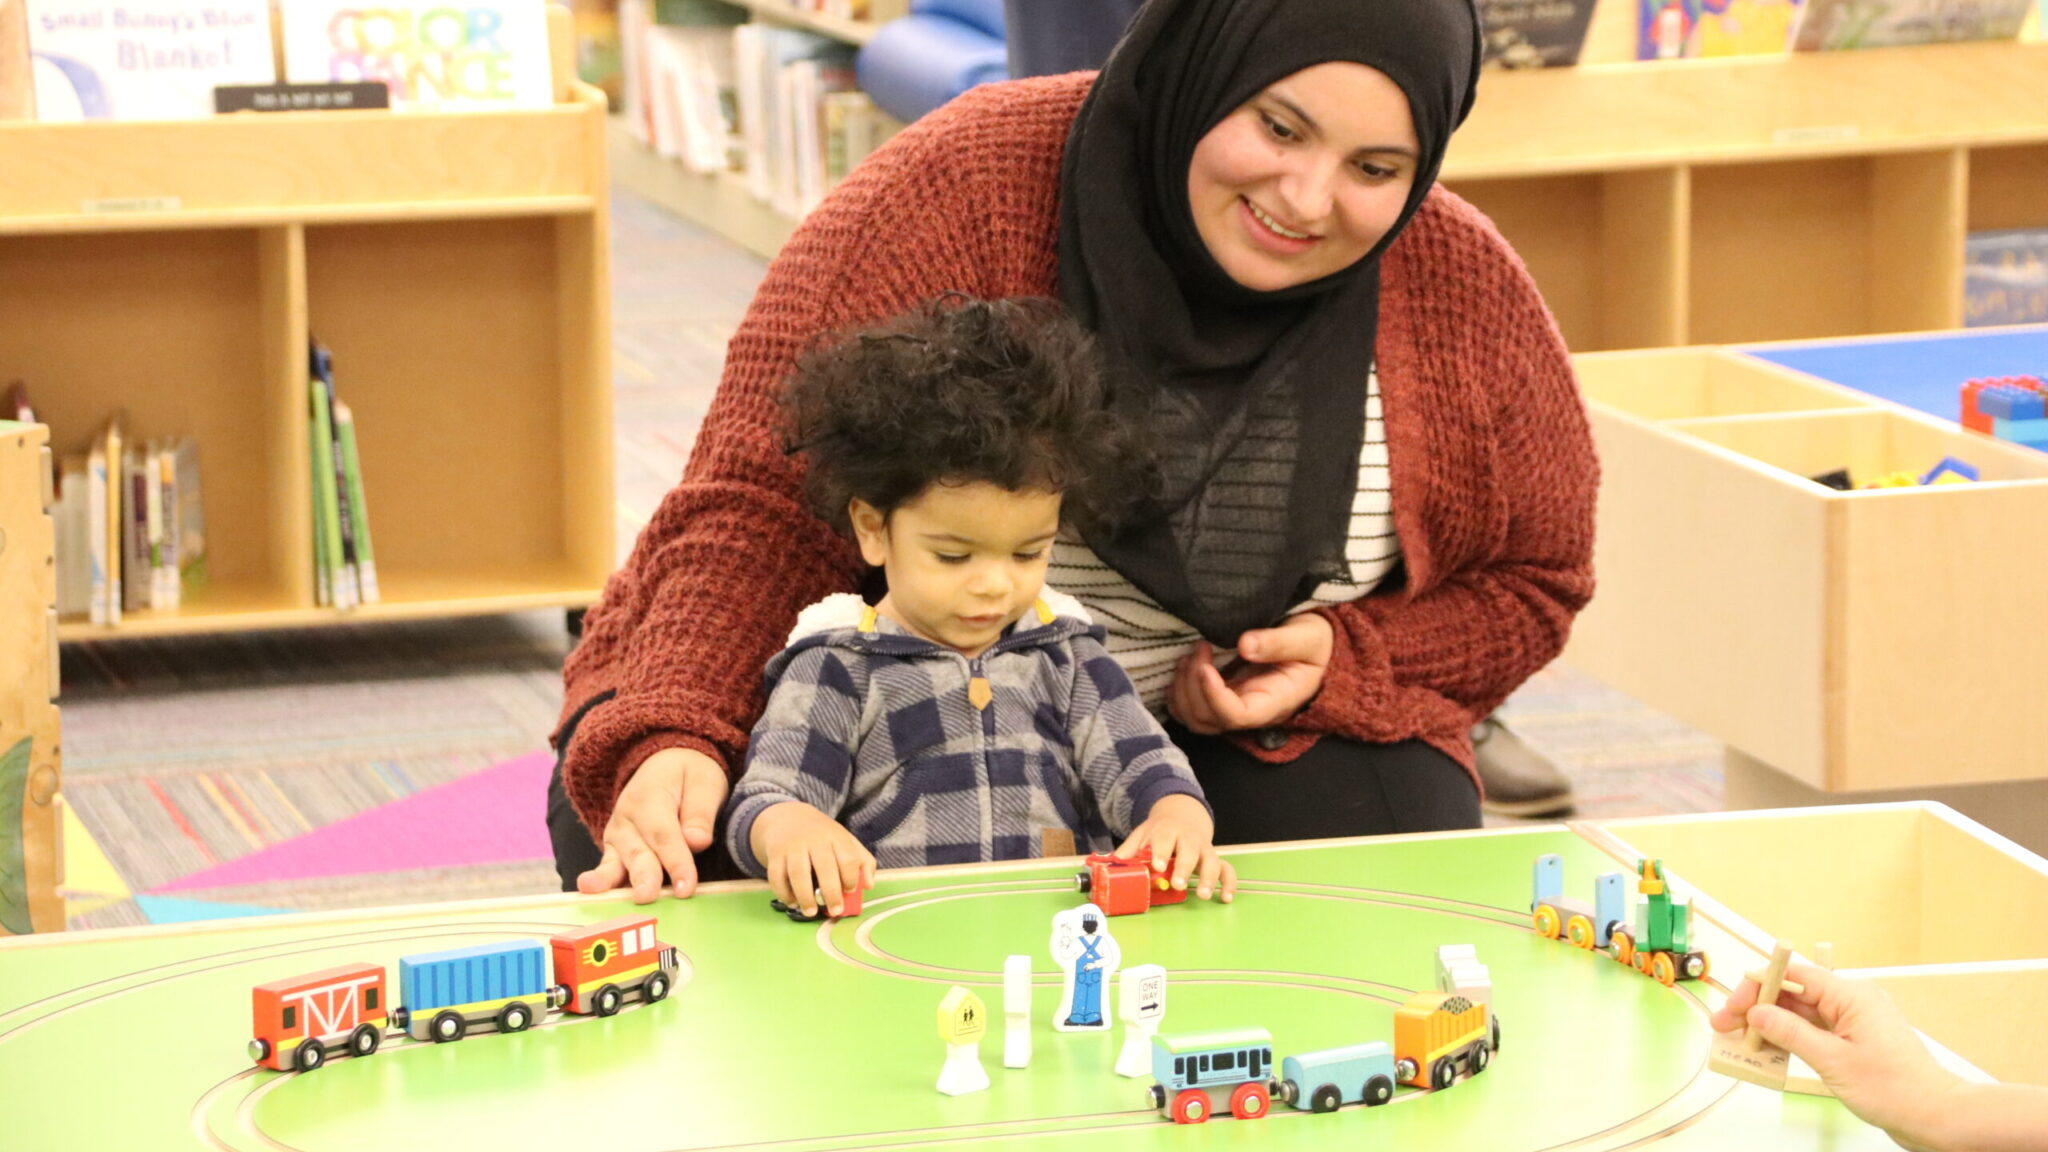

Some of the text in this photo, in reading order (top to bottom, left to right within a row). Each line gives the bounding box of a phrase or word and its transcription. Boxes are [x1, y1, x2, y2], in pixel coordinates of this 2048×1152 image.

[328, 8, 502, 55] COLOR
[117, 38, 231, 70] Blanket
[1143, 980, 1158, 991] ONE
[1142, 992, 1158, 1001] WAY
